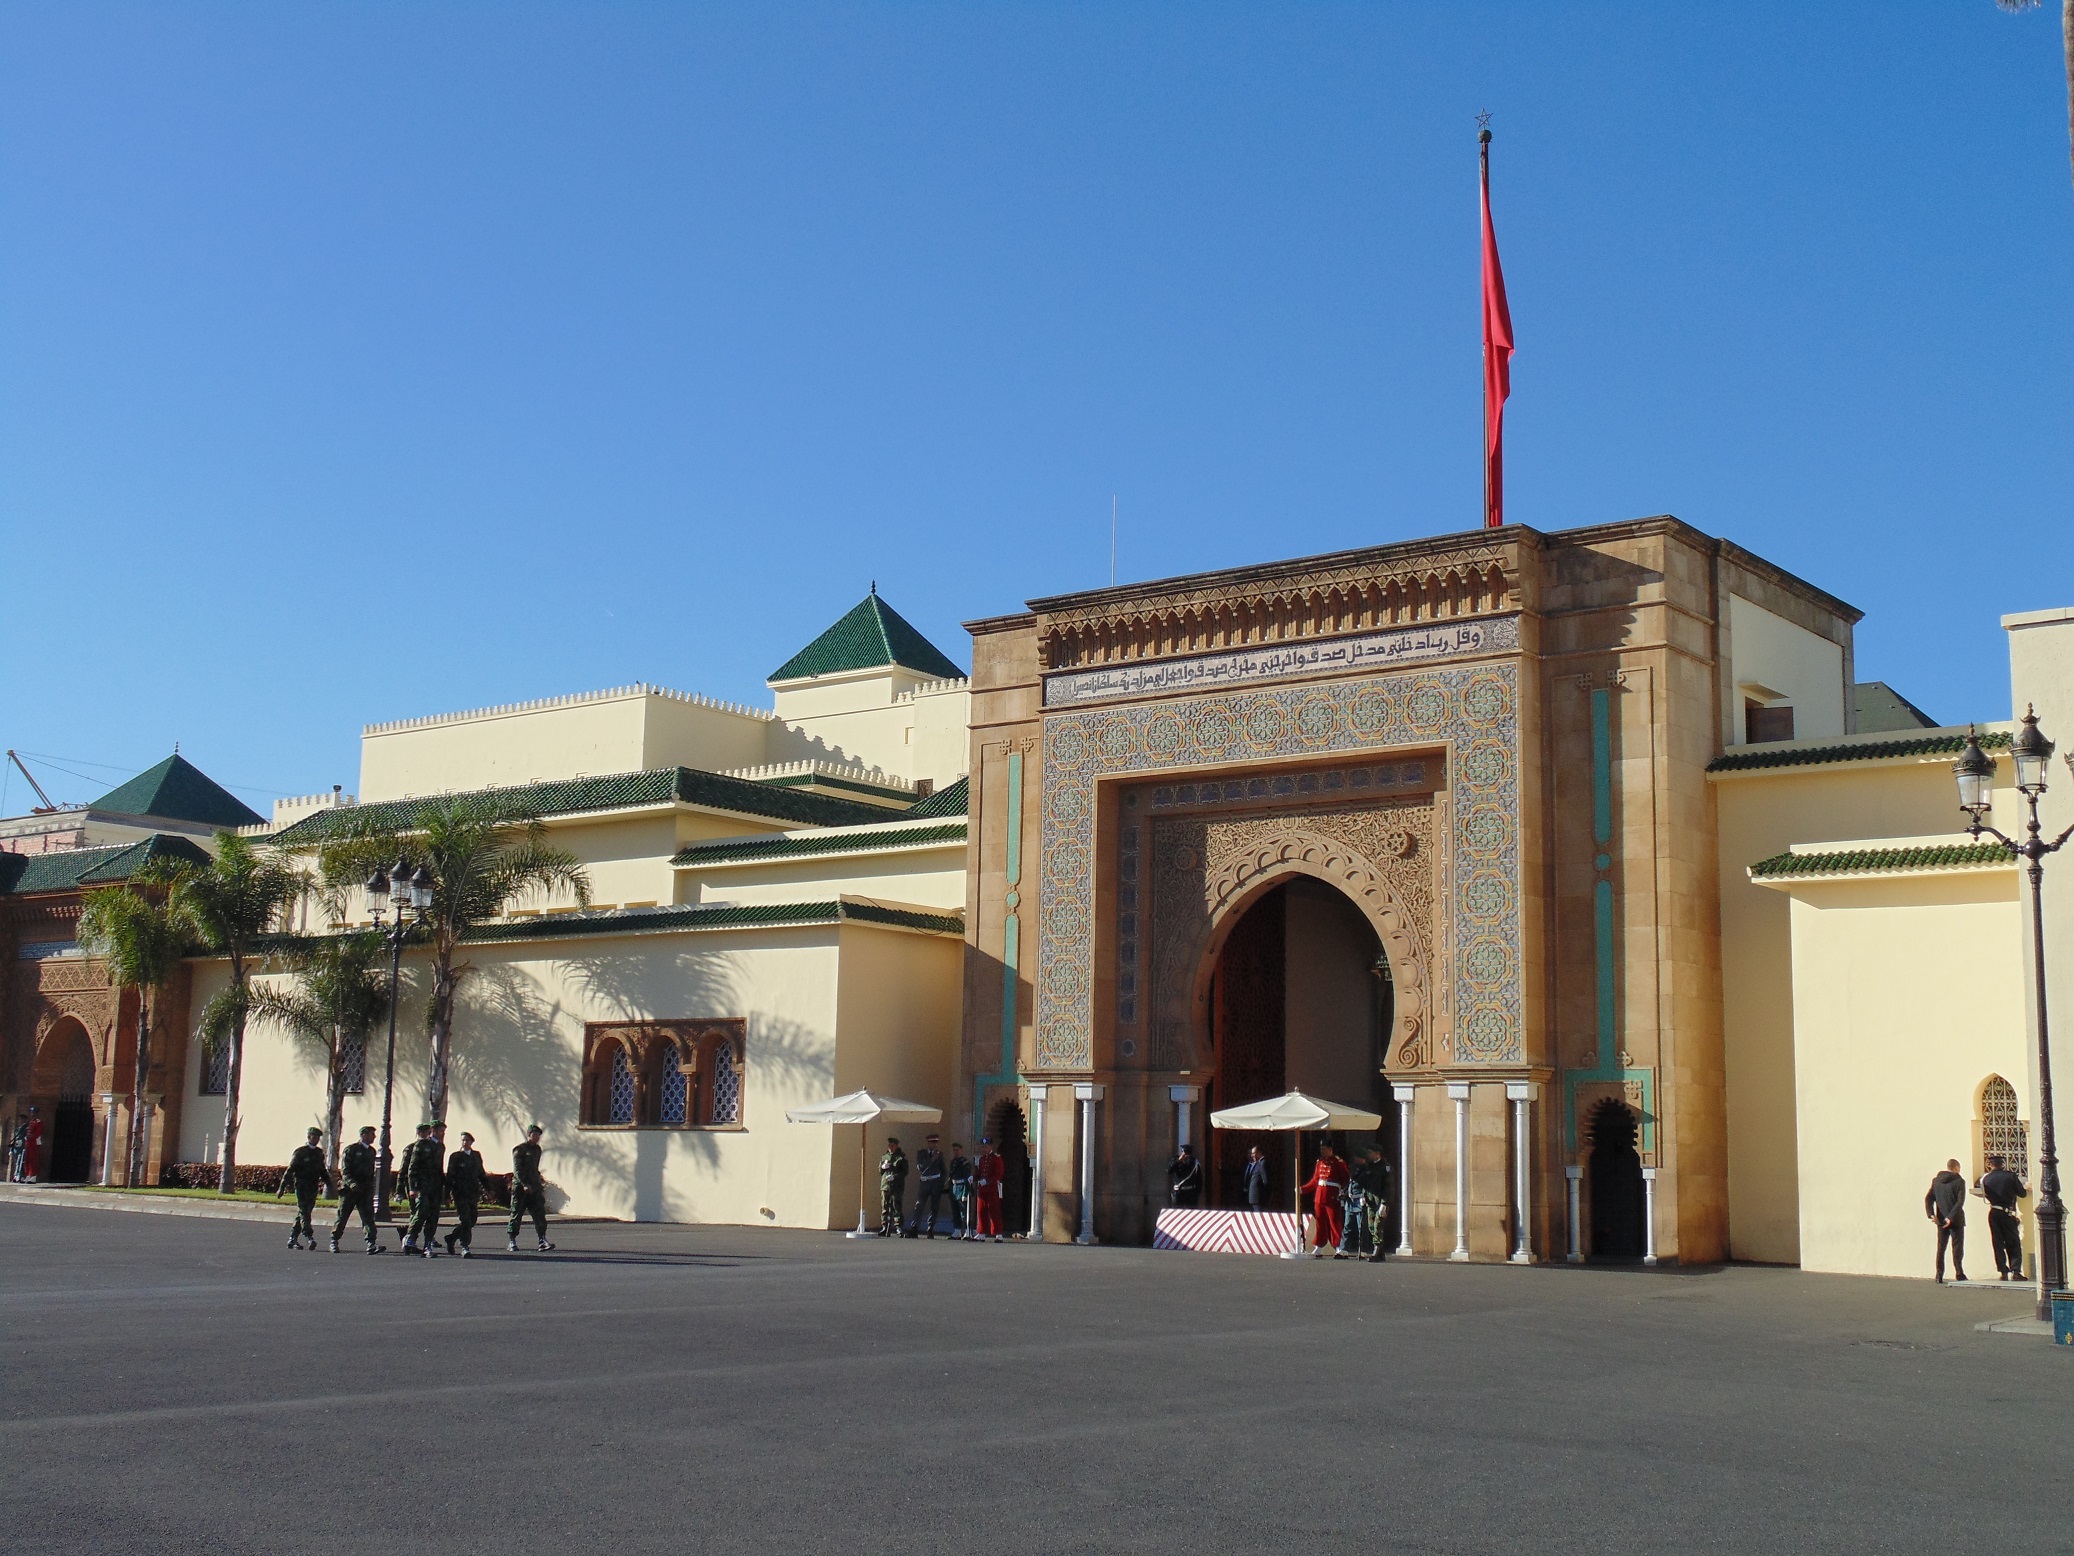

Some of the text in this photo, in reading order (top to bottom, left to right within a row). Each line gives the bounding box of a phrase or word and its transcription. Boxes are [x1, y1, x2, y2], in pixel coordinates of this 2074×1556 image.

[1450, 627, 1481, 651] وقل
[1305, 647, 1346, 664] صدق
[1346, 641, 1386, 664] مدخل
[1193, 661, 1228, 679] صدق
